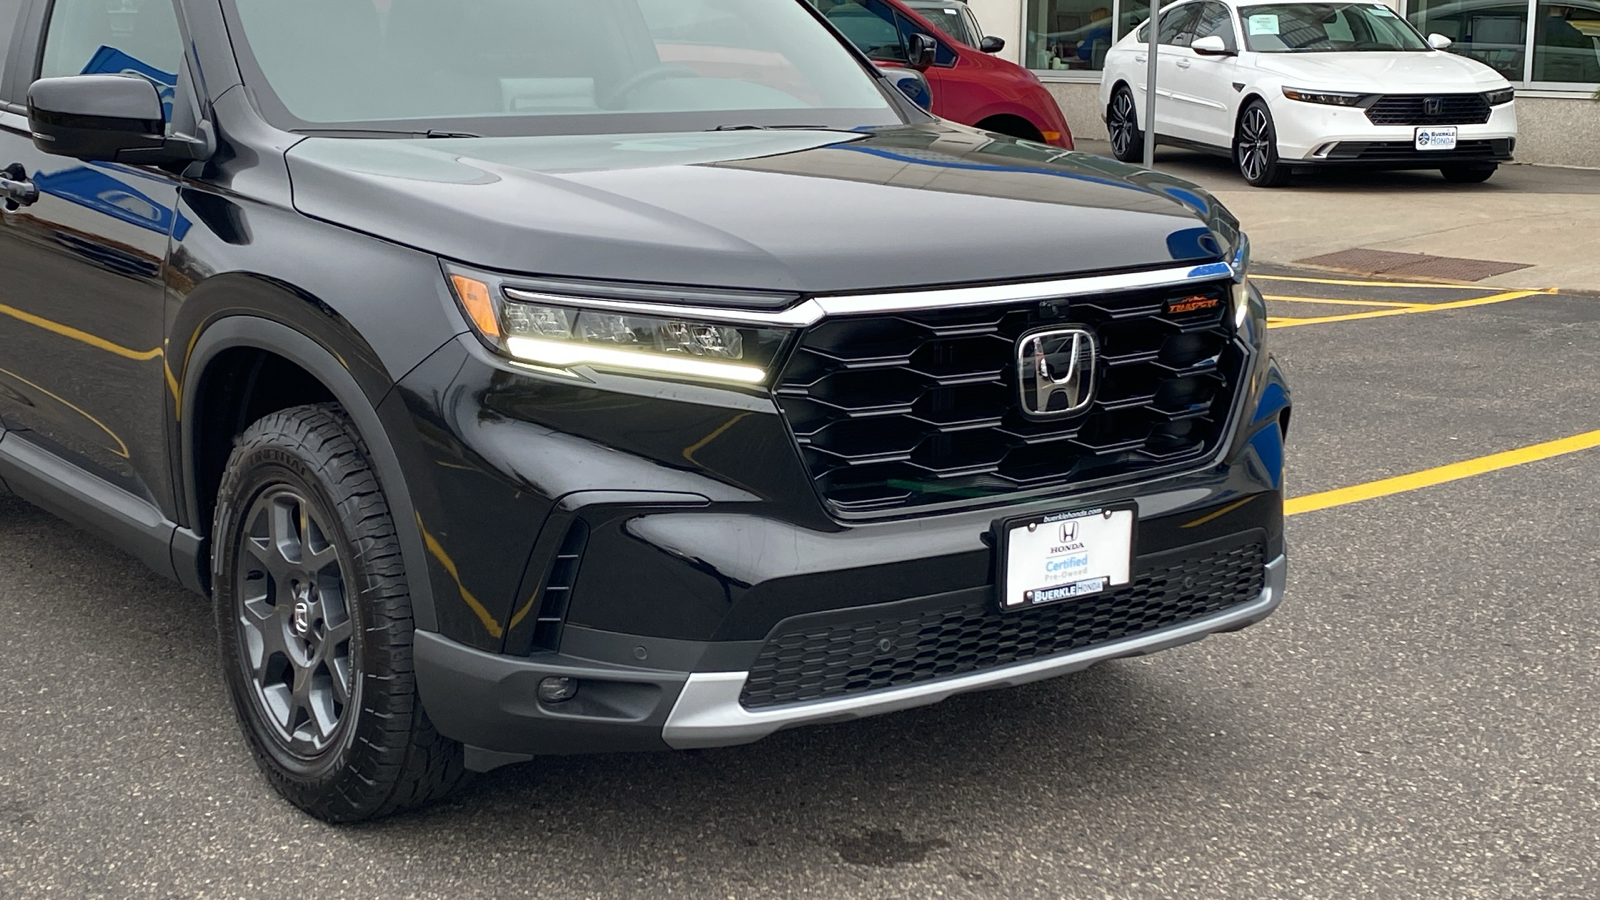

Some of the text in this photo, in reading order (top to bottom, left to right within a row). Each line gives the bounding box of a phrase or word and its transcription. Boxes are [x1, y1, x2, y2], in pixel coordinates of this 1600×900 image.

[1431, 136, 1454, 145] HONDA
[1043, 508, 1102, 522] buerklehonda.com
[1050, 542, 1085, 554] HONDA
[1045, 554, 1088, 572] Certified
[1044, 567, 1088, 581] Pre-Owned
